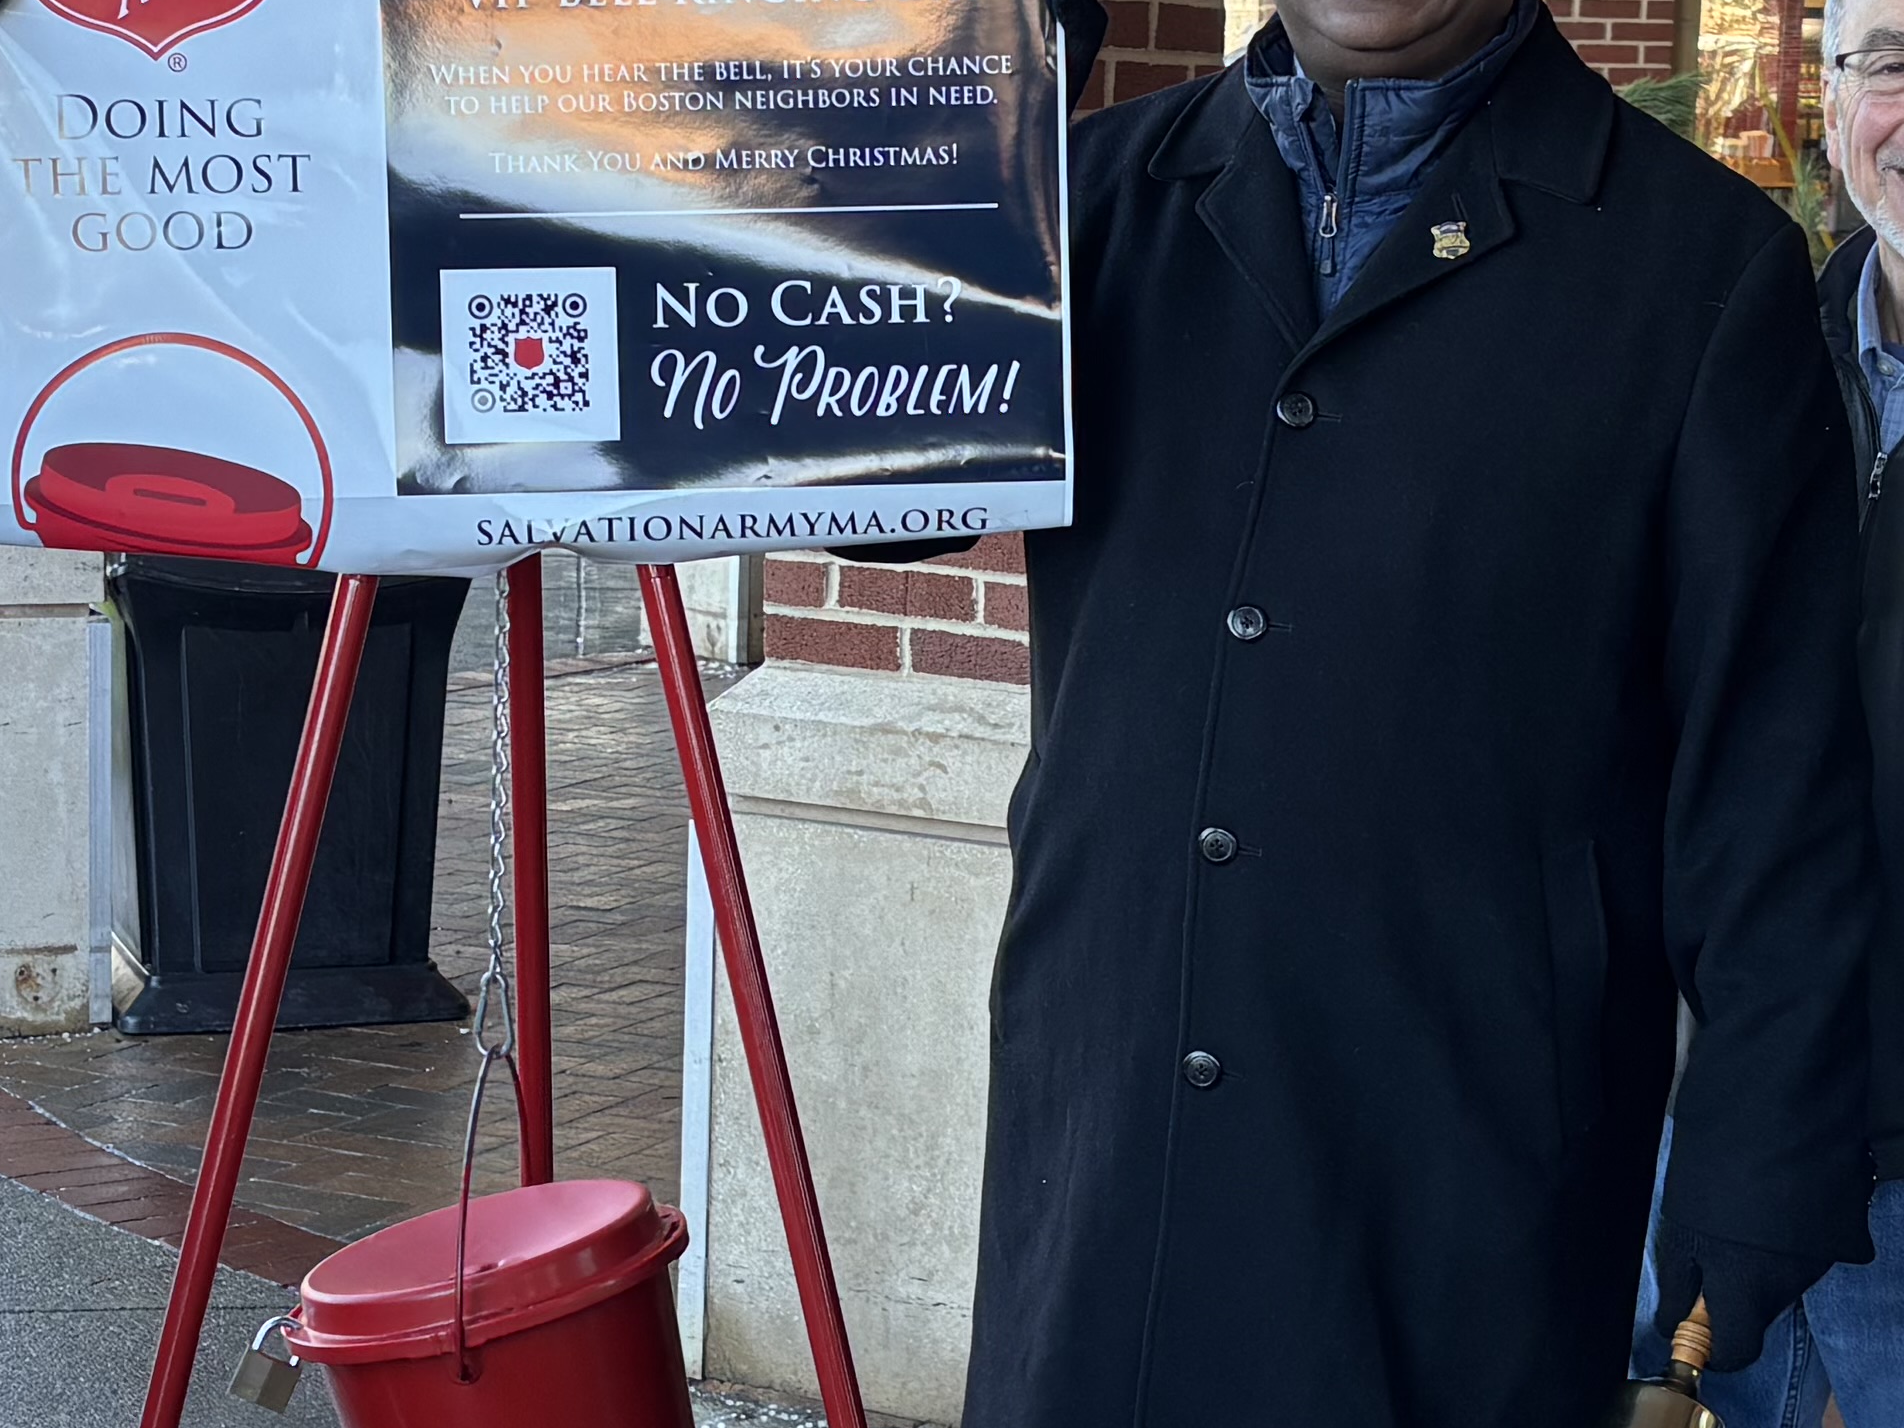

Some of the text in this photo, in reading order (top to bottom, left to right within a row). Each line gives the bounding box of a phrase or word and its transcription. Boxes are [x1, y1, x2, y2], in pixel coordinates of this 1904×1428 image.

[429, 55, 1012, 85] WHEN YOU HEAR THE BELL, IT'S YOUR CHANCE
[56, 93, 266, 141] DOING
[444, 85, 998, 115] TO HELP OUR BOSTON NEIGHBORS IN NEED.
[11, 152, 312, 197] THE MOST
[488, 143, 958, 173] THANK YOU AND MERRY CHRISTMAS!
[71, 210, 253, 253] GOOD
[652, 276, 962, 329] NO CASH?
[650, 344, 1020, 430] NO PROBLEM!
[475, 505, 991, 548] SALVATIONARMYMA.ORG
